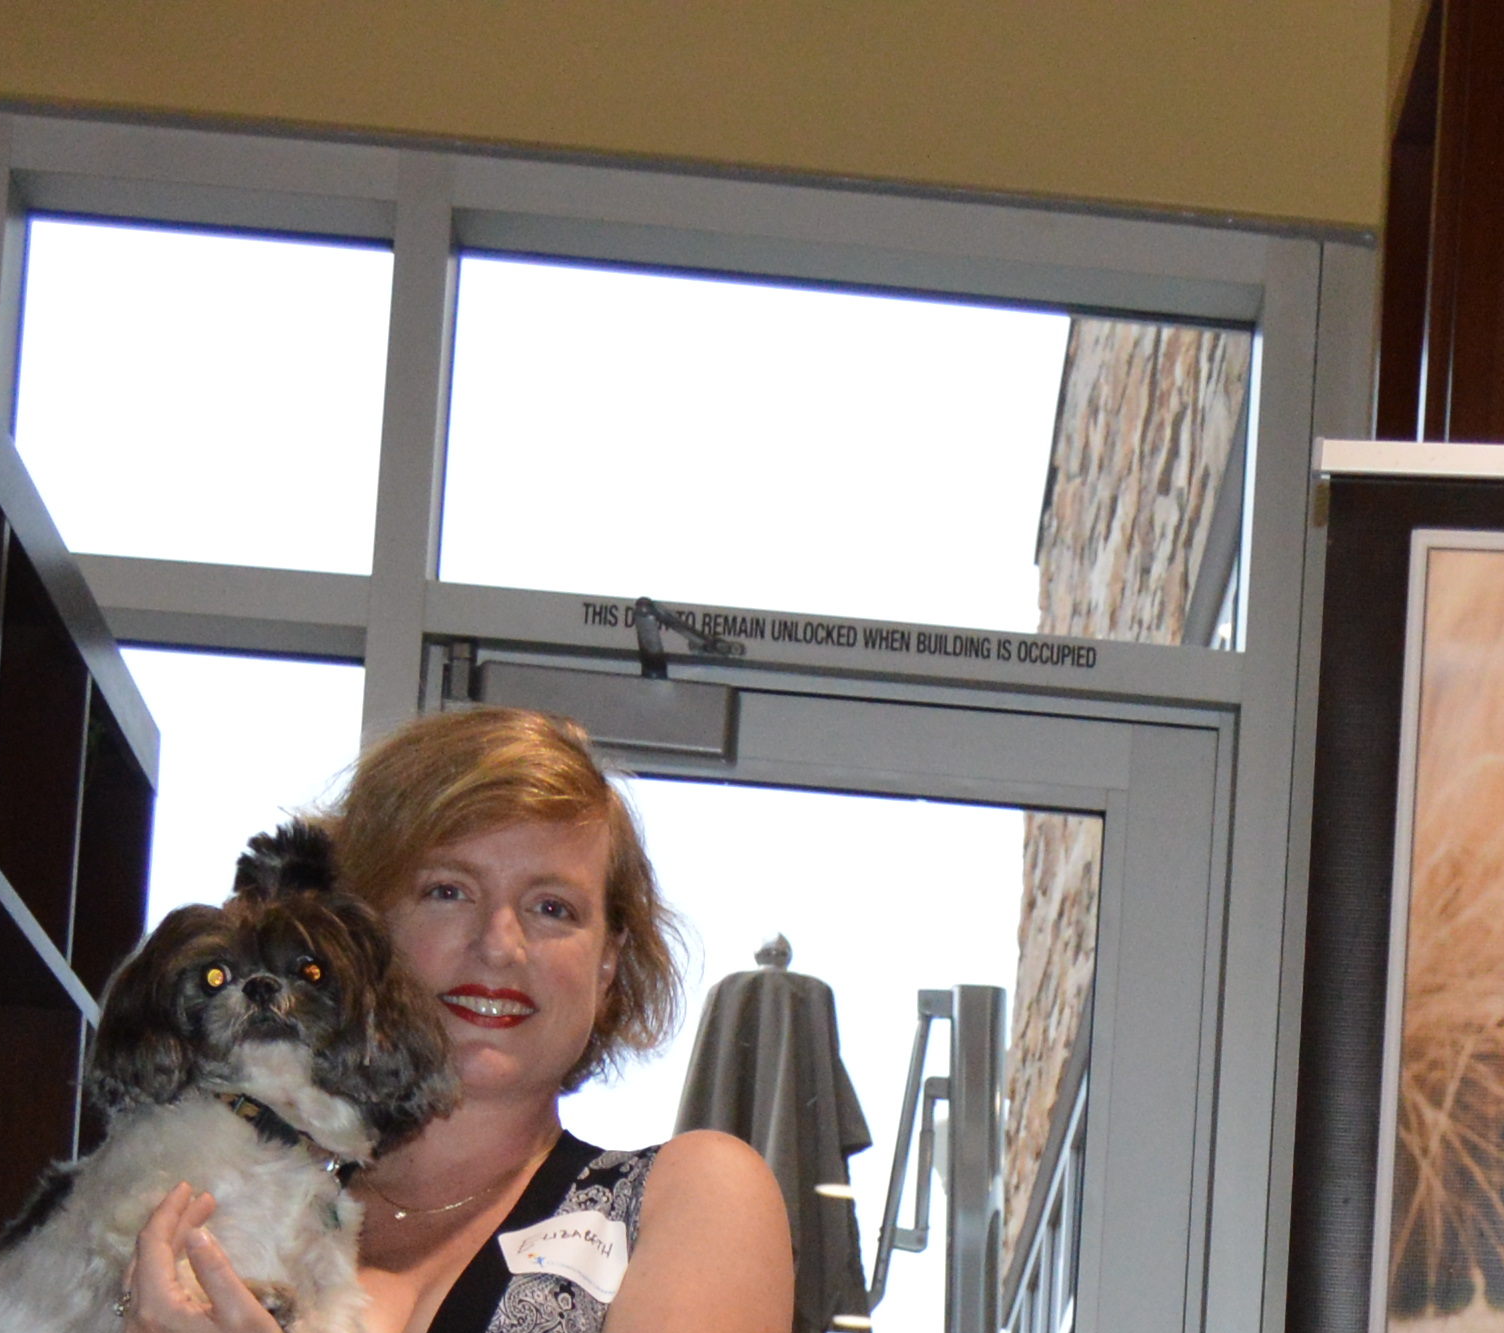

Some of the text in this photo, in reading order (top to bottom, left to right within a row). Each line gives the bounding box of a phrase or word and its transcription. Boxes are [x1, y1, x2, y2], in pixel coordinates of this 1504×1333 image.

[583, 602, 619, 627] THIS
[701, 612, 766, 640] REMAIN
[771, 618, 858, 648] UNLOCKED
[863, 628, 913, 652] WHEN
[916, 631, 992, 659] BUILDING
[997, 639, 1012, 661] IS
[1017, 640, 1097, 668] OCCUPIED
[517, 1229, 614, 1259] ELIZABETH
